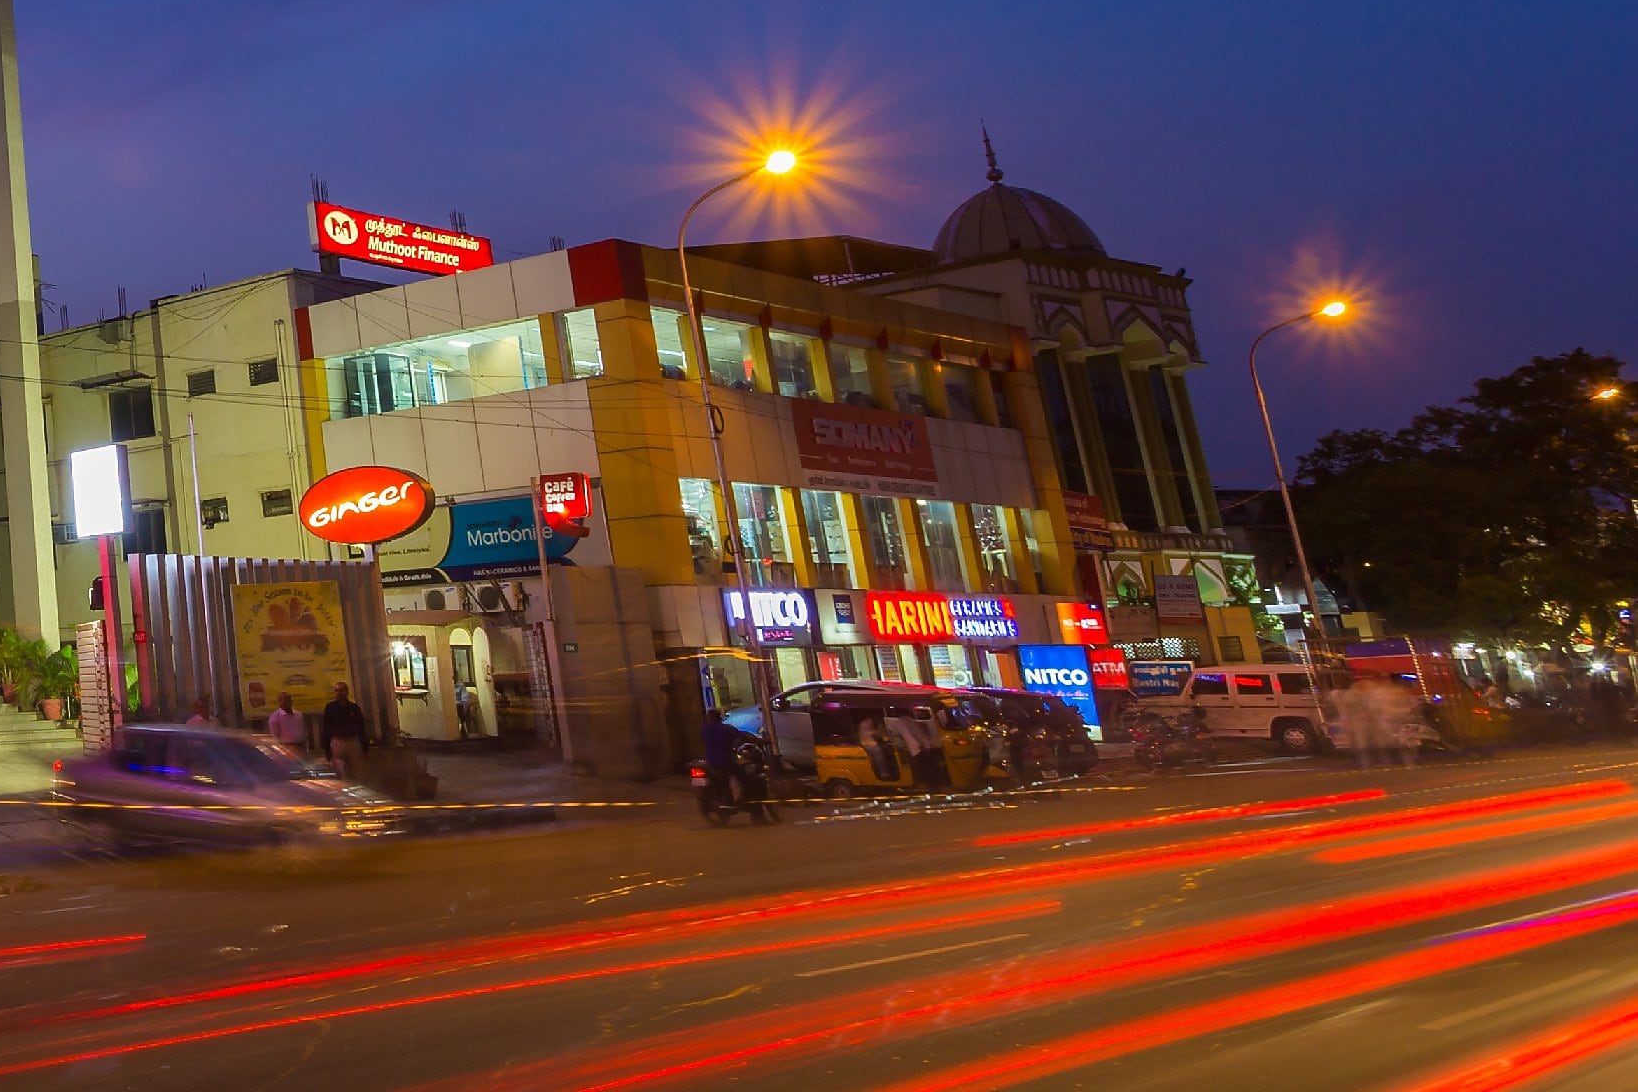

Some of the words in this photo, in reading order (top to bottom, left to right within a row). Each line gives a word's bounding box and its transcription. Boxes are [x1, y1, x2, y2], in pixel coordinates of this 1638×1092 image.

[368, 236, 418, 257] Muthoot
[418, 246, 460, 267] Finance
[812, 417, 912, 454] SOMANY
[467, 524, 553, 547] Marbonie
[1024, 668, 1088, 686] NITCO
[1093, 662, 1126, 674] ATM
